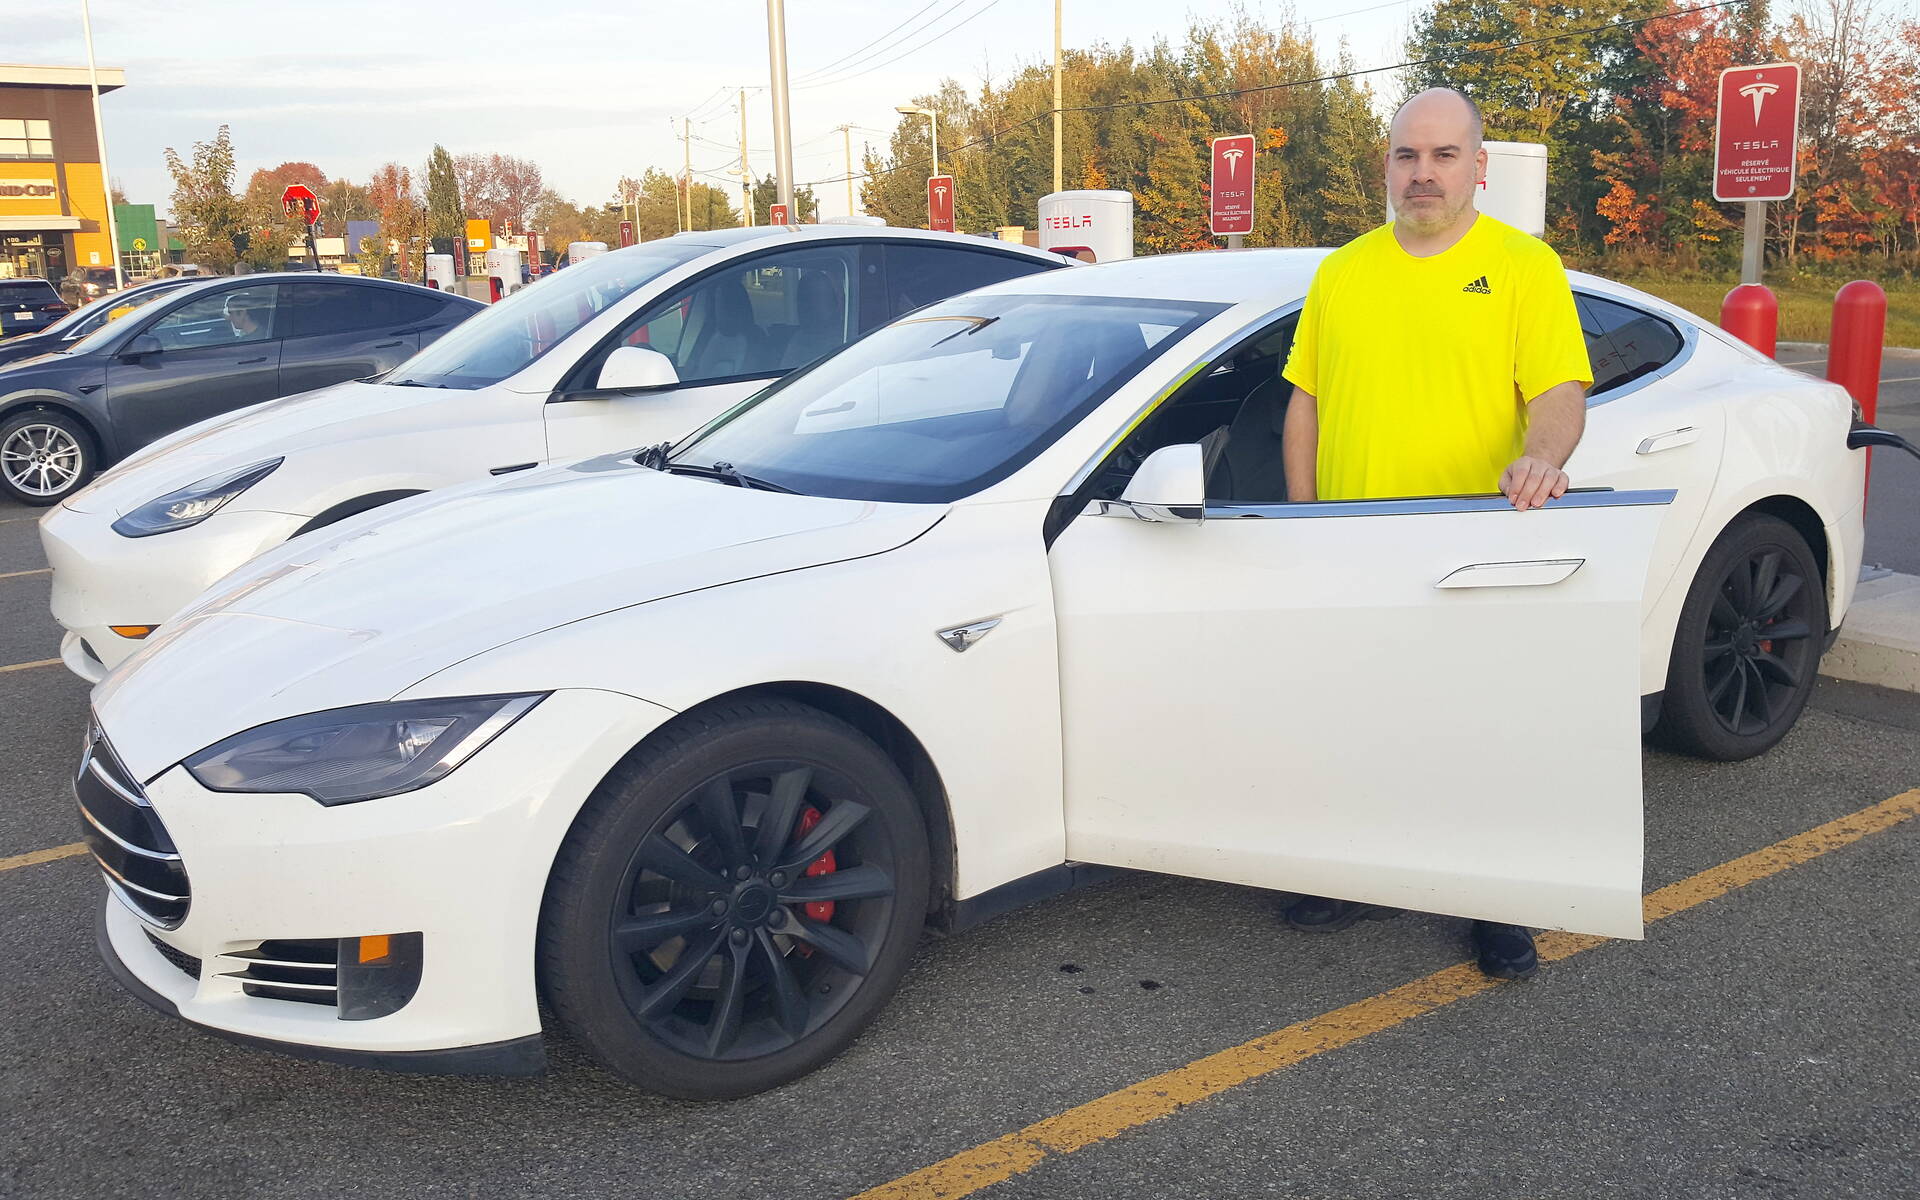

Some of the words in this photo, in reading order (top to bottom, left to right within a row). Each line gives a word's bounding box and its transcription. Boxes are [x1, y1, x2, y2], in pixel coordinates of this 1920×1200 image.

[1733, 140, 1779, 150] TESLA
[1741, 158, 1769, 166] RÉSERVÉ
[1750, 166, 1790, 174] ÉLECTRIQUE
[1735, 175, 1772, 183] SEULEMENT
[1220, 190, 1245, 198] TESLA
[1045, 215, 1092, 230] TESLA
[1462, 286, 1491, 294] adidas
